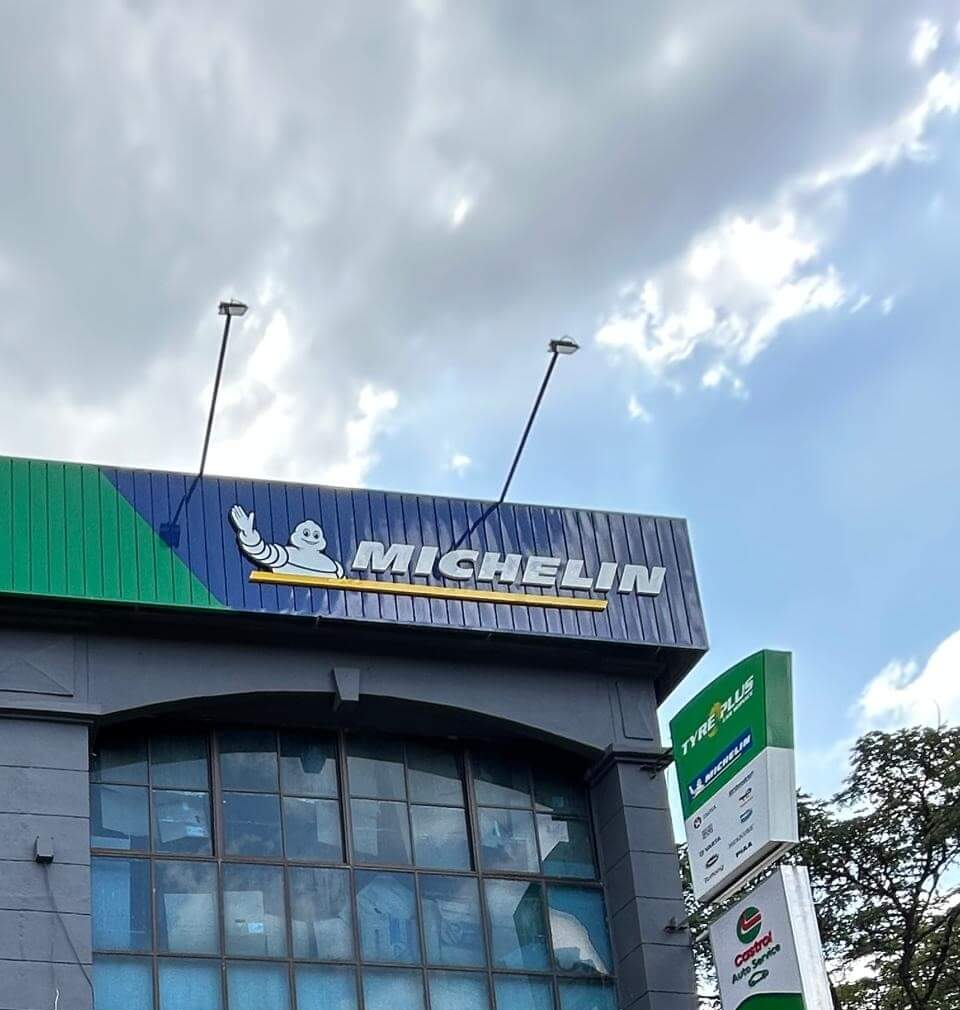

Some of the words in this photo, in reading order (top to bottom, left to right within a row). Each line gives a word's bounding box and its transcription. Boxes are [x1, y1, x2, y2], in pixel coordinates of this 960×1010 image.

[351, 541, 666, 598] MICHELIN
[704, 734, 751, 782] MICHELIN
[732, 966, 751, 985] Auto
[752, 944, 781, 969] Service
[735, 931, 772, 967] Castrol
